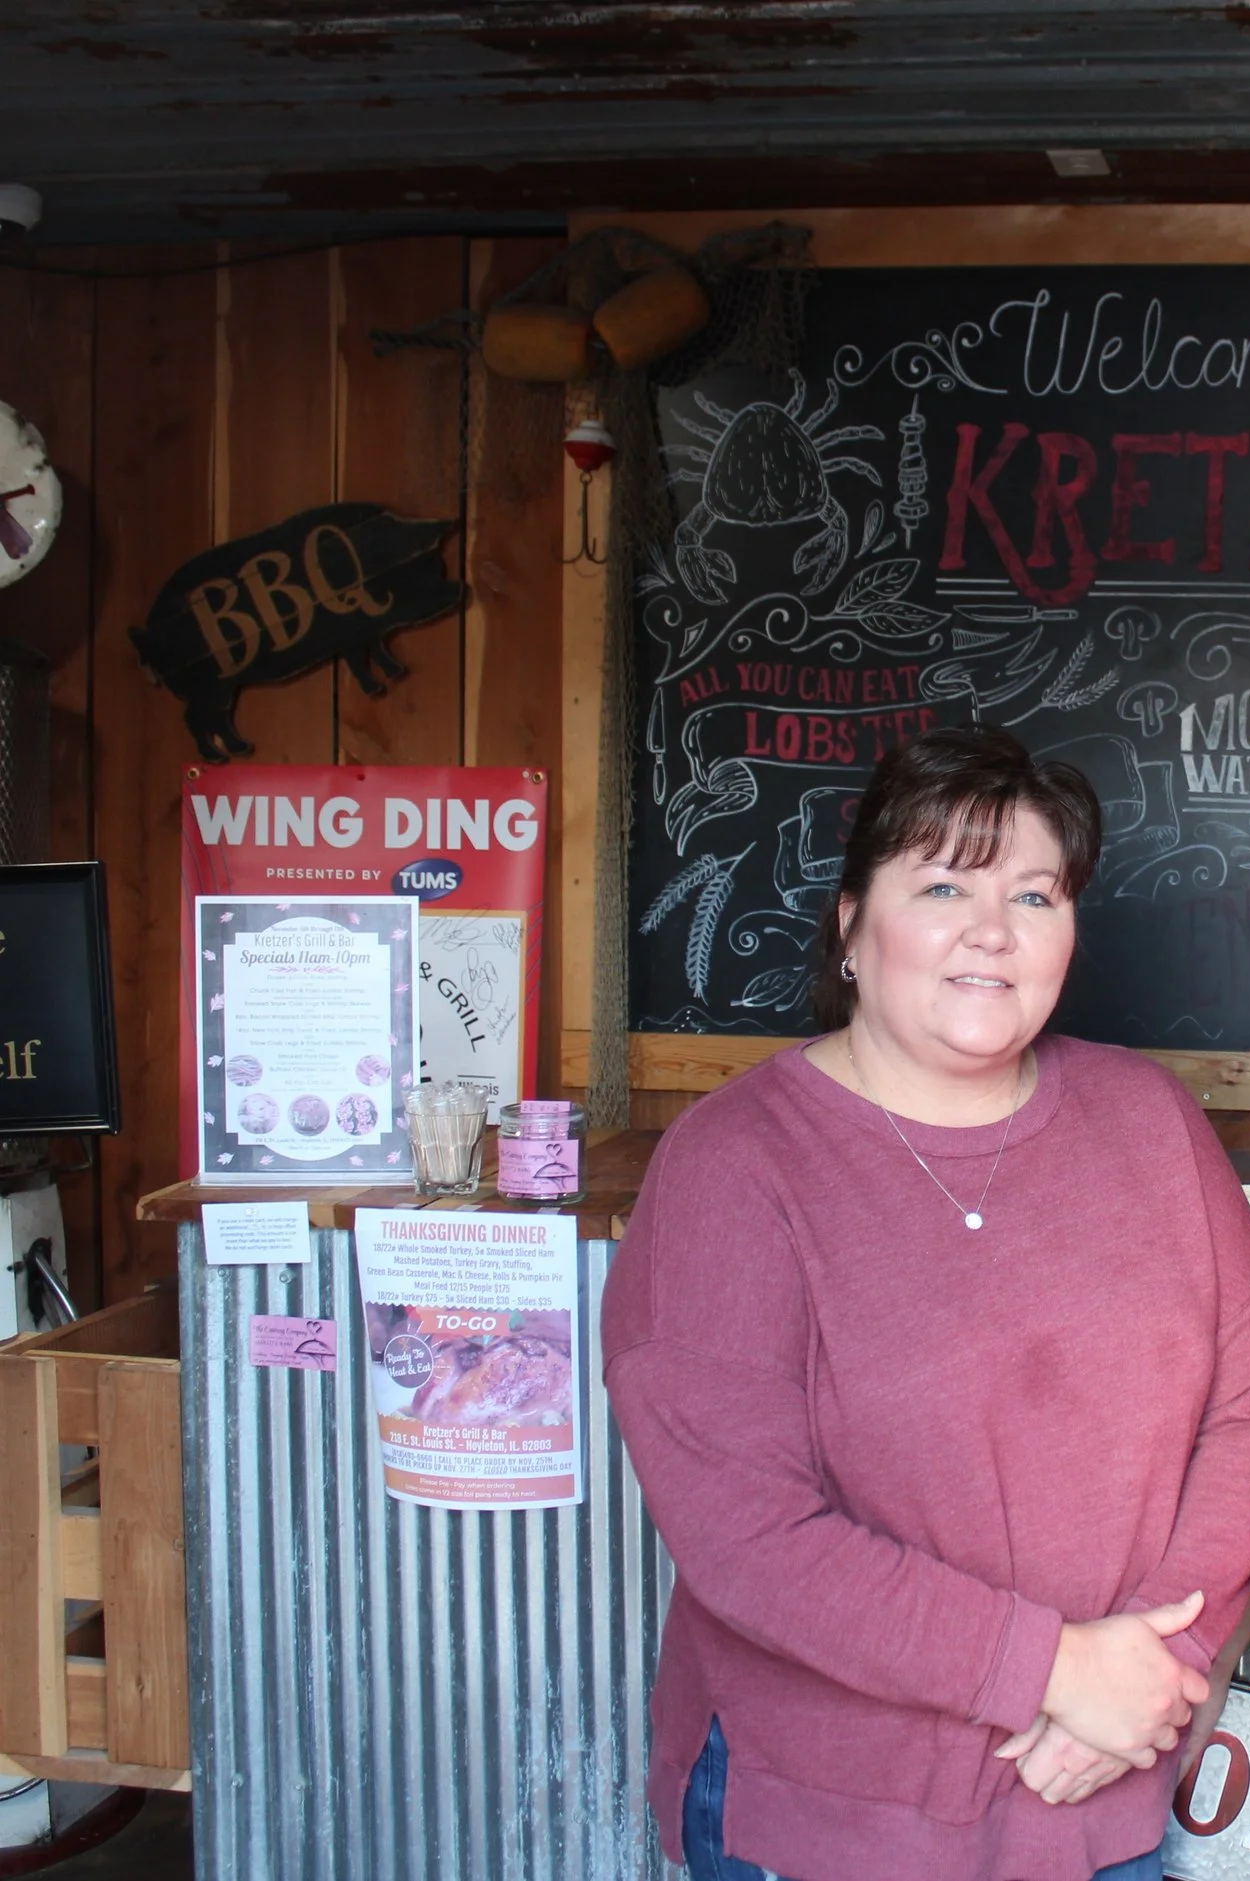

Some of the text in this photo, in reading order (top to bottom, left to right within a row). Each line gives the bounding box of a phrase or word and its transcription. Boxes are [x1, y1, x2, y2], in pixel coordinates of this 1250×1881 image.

[189, 524, 393, 679] BBQ
[679, 662, 921, 707] ALL YOU CAN EAT
[190, 794, 538, 851] WING DING
[266, 867, 458, 890] PRESENTED BY TUMS
[254, 933, 355, 947] Kretzer's Grill & Bar
[239, 949, 371, 967] Specials 11am-10pm
[437, 977, 486, 1053] GRILL
[381, 1221, 546, 1244] THANKSGIVING DINNER
[398, 1244, 419, 1253] Whole
[420, 1245, 447, 1254] Smoked
[450, 1246, 474, 1257] Turkey,
[486, 1247, 514, 1256] Smoked
[515, 1247, 537, 1257] Sliced
[538, 1248, 554, 1257] Ham
[394, 1256, 532, 1271] Mashed Potatoes, Turkey Gravy, Stuffing,
[367, 1266, 563, 1283] Green Bean Casserole, Mac & Cheese, Rolls & Pumpkin Pie
[414, 1281, 510, 1293] Meal Feed 12/15 People $175
[401, 1292, 423, 1302] Turkey
[425, 1293, 438, 1302] $75
[456, 1294, 477, 1304] Sliced
[478, 1295, 494, 1304] Ham
[496, 1295, 510, 1305] $30
[517, 1296, 537, 1305] Sides
[538, 1297, 552, 1306] $35
[436, 1315, 496, 1330] TO-GO
[386, 1348, 425, 1364] Ready To
[389, 1362, 431, 1377] Heat & Eat
[423, 1425, 507, 1440] Kretzer's Grill & Bar
[390, 1431, 402, 1443] 218
[410, 1435, 421, 1446] St.
[422, 1436, 443, 1448] Louis
[444, 1438, 456, 1450] St.
[466, 1439, 507, 1453] Hoyleton,
[522, 1439, 552, 1451] 62803
[413, 1460, 432, 1469] PICKED
[484, 1465, 508, 1475] CLOSED
[510, 1463, 558, 1473] THANKSGIVING
[559, 1462, 572, 1470] DAY
[438, 1456, 452, 1464] CALL
[454, 1456, 461, 1464] TO
[485, 1457, 505, 1465] ORDER
